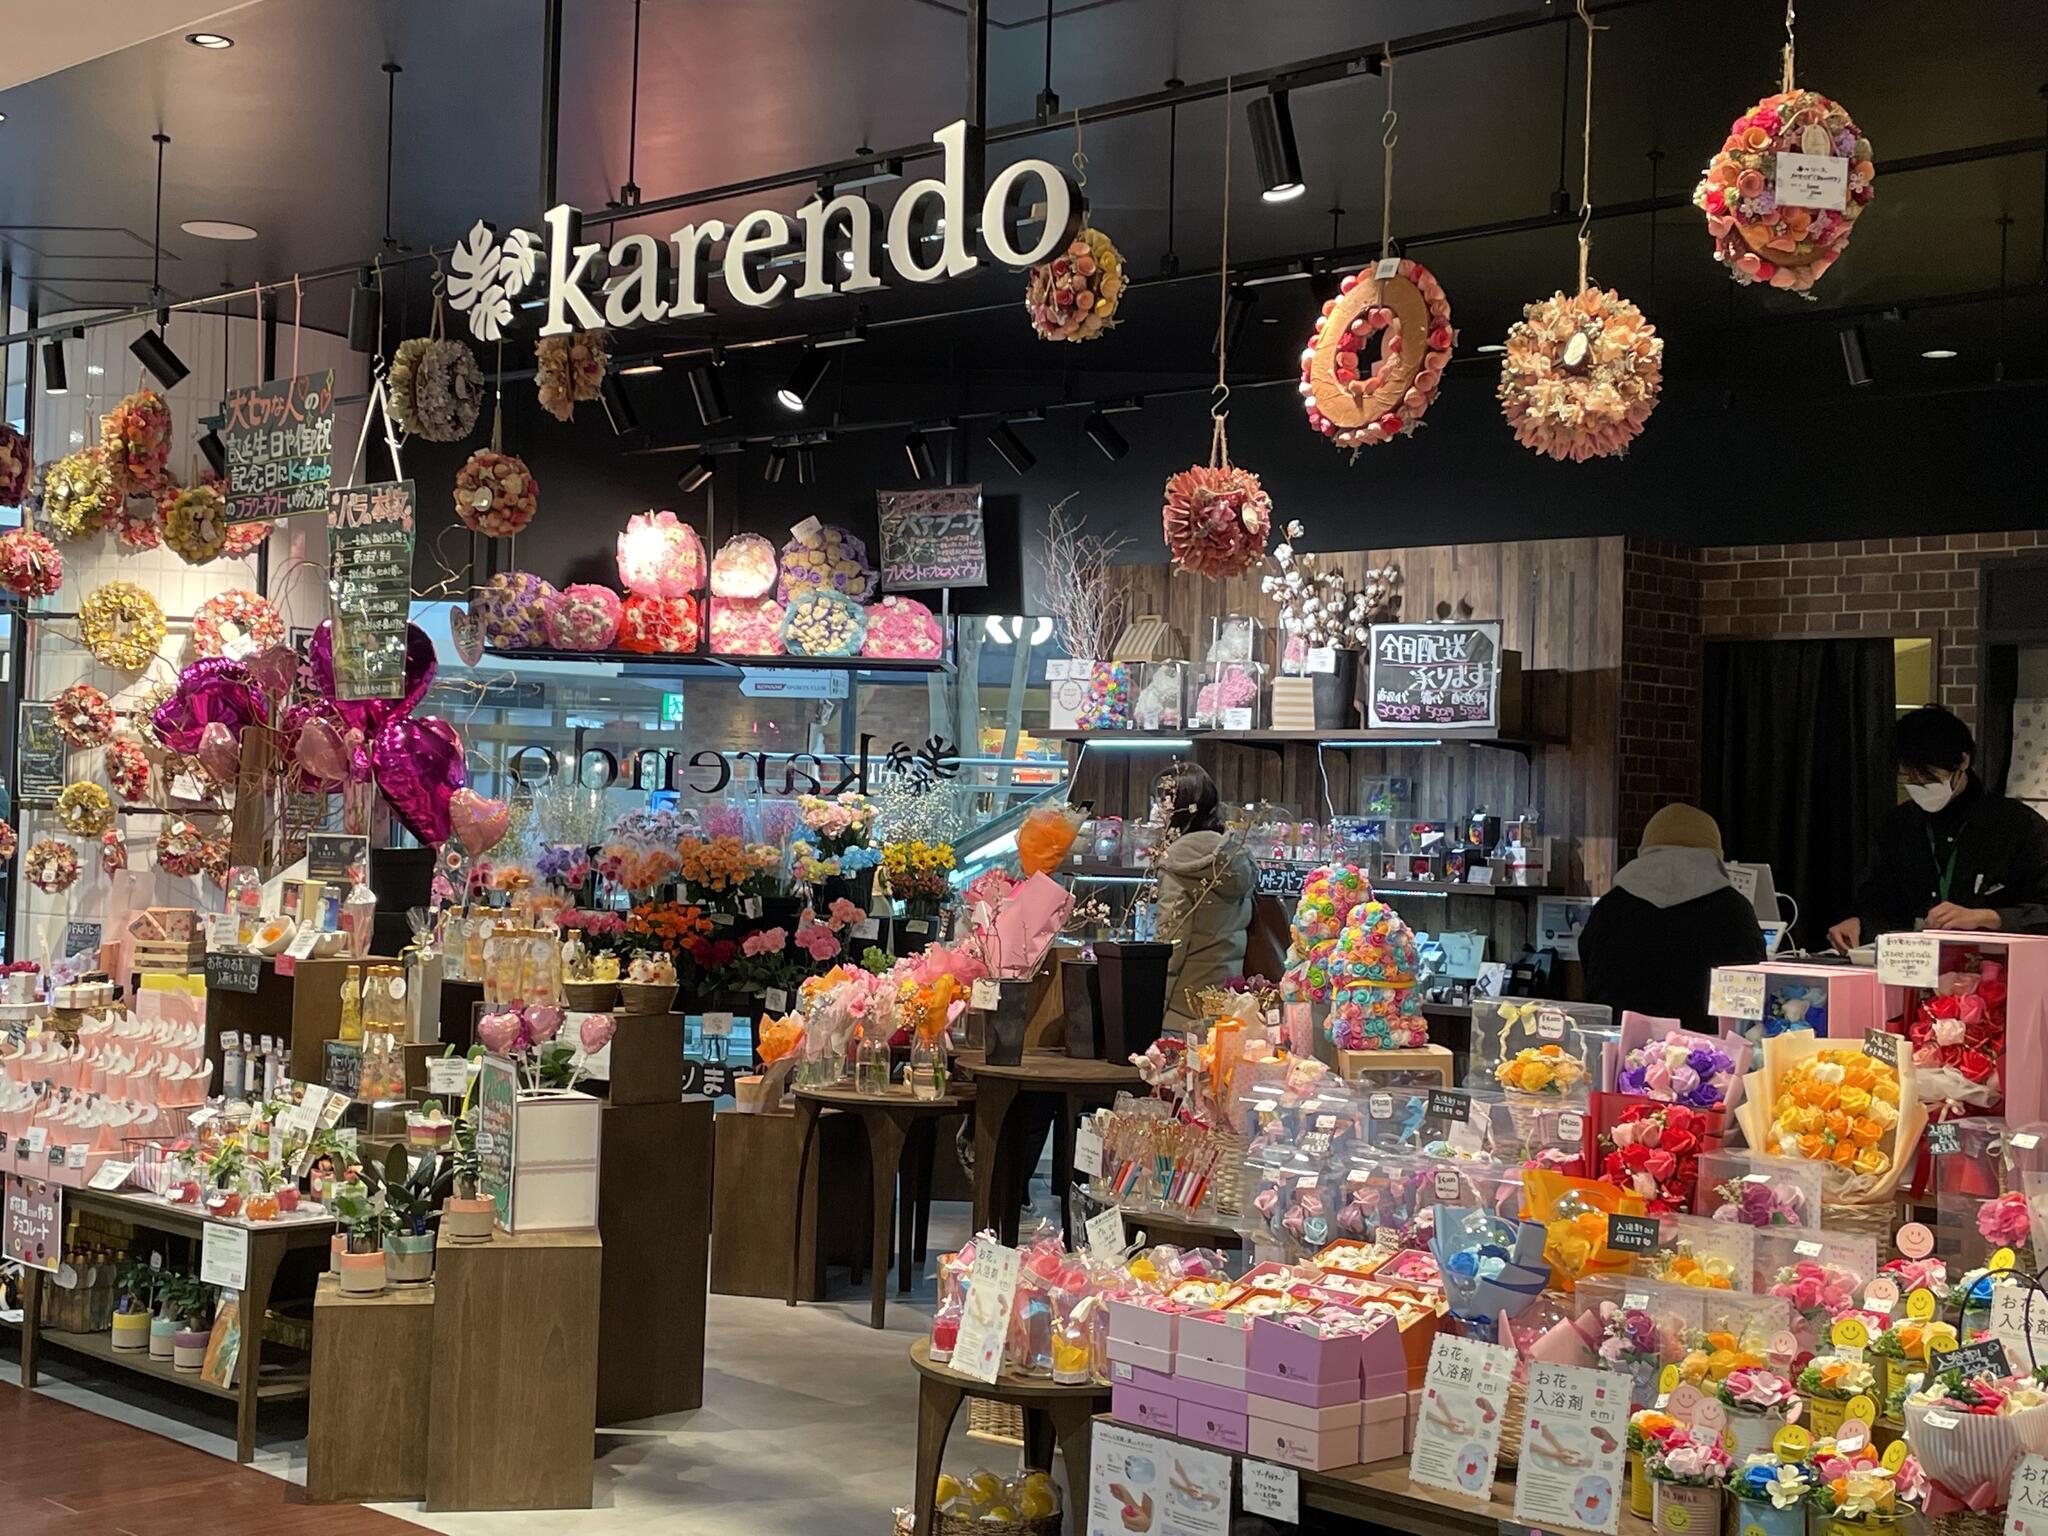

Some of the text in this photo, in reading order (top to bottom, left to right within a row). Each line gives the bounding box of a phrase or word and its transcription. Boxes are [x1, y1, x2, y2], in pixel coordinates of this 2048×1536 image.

[539, 119, 1074, 338] karendo
[226, 381, 319, 432] 大切な人の
[1379, 634, 1469, 664] 全国配送
[1408, 662, 1490, 693] 承ります
[13, 1216, 50, 1240] チョコレート
[1437, 1344, 1470, 1362] お花の
[1432, 1360, 1474, 1383] 入浴剤
[1535, 1370, 1578, 1390] お花の
[1476, 1382, 1498, 1393] emi
[1532, 1389, 1583, 1411] 入浴剤
[1589, 1409, 1615, 1421] emi
